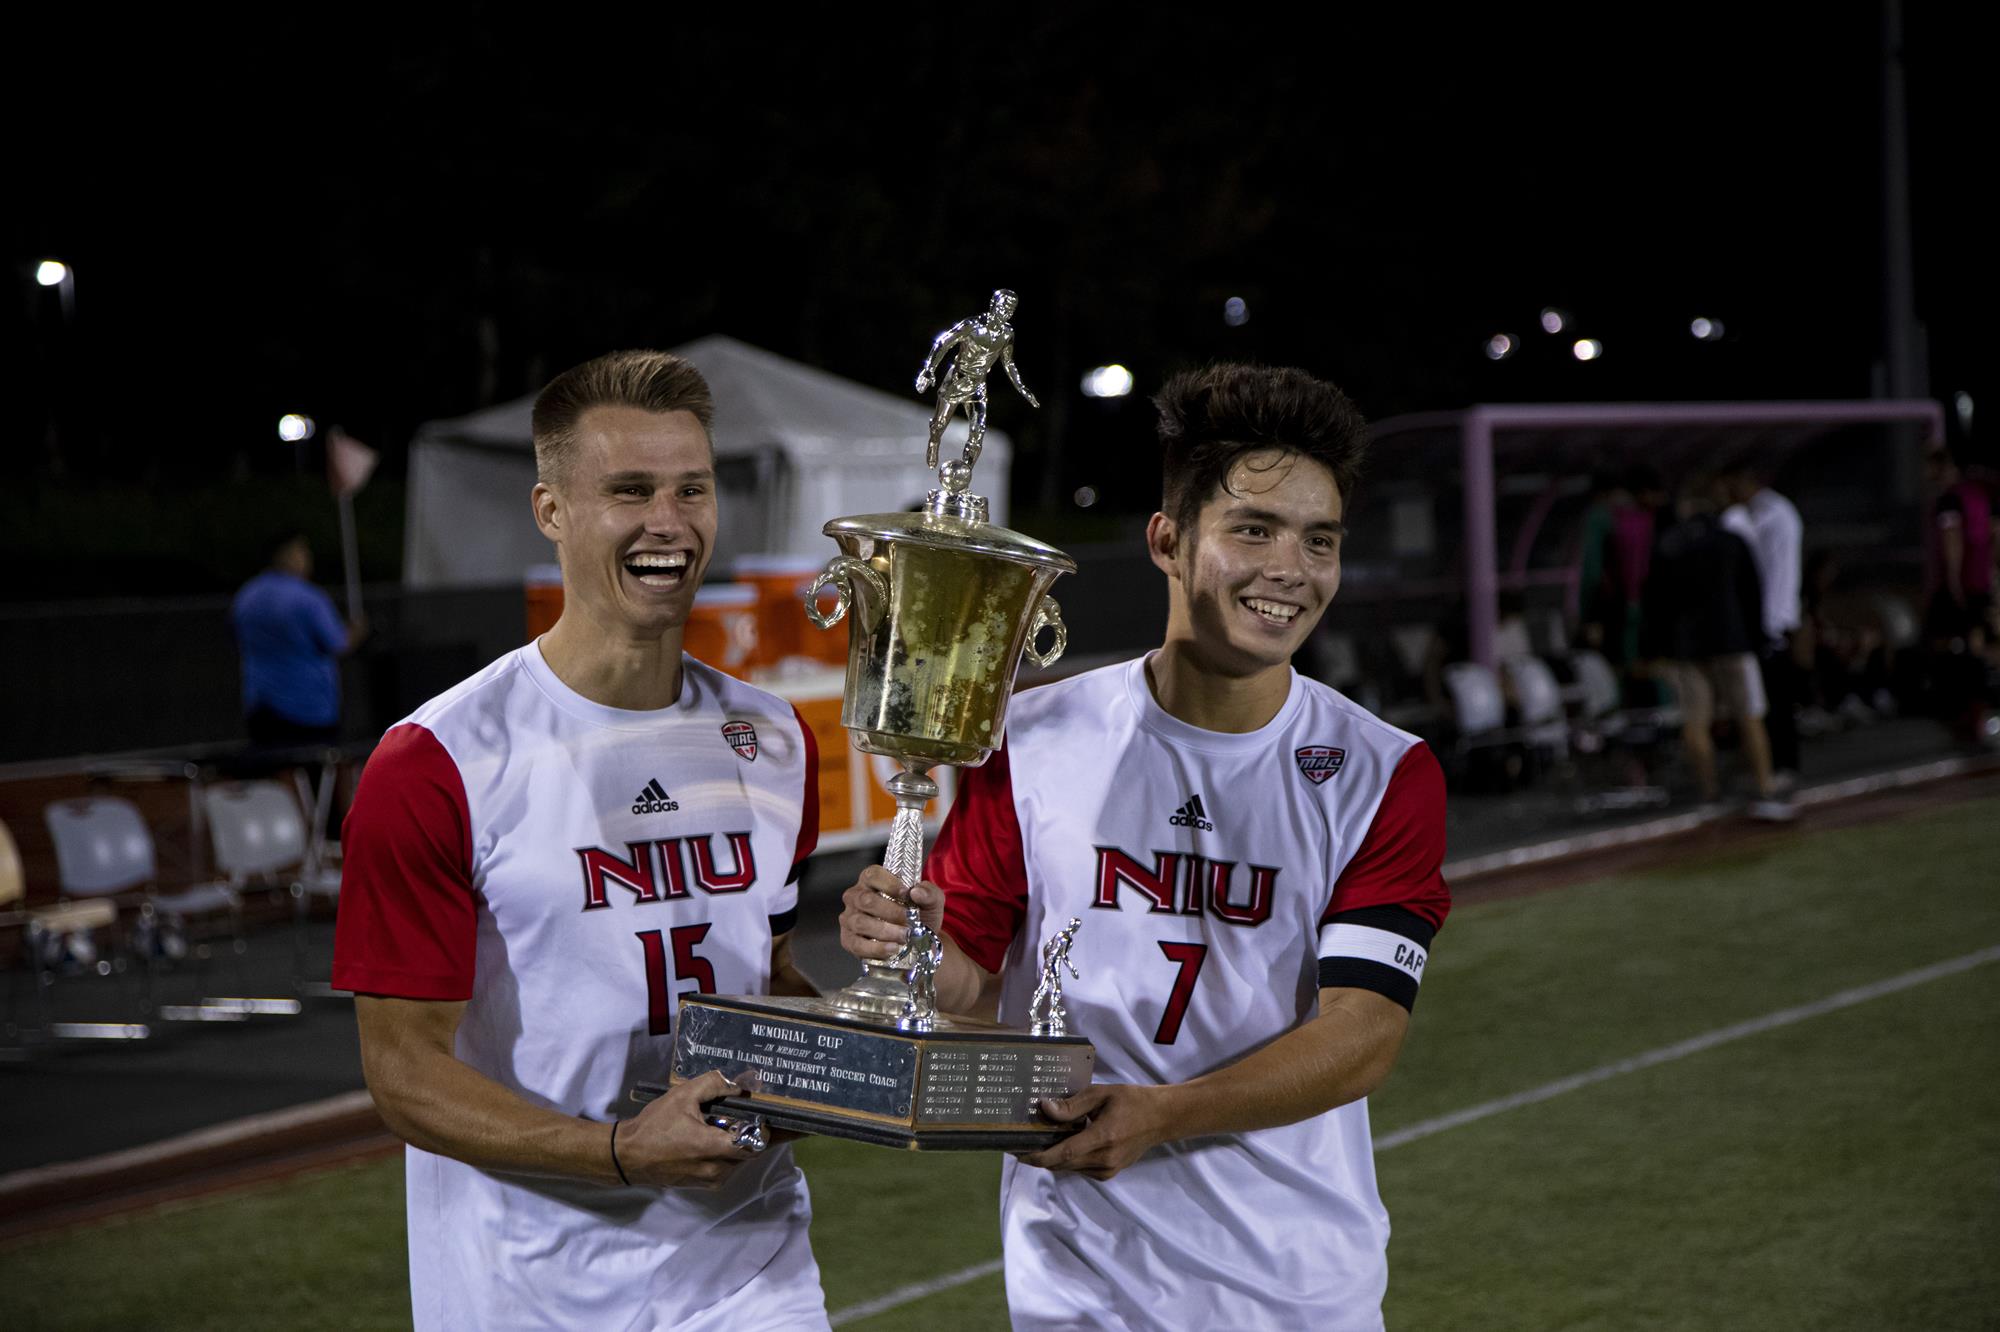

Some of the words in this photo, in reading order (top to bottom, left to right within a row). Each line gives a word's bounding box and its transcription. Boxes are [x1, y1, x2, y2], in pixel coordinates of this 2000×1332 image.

[727, 732, 757, 746] MAC
[1299, 757, 1342, 769] MAC
[631, 799, 679, 815] adidas
[1169, 813, 1213, 832] adidas
[573, 831, 757, 912] NIU
[1089, 844, 1283, 928] NIU
[635, 922, 717, 1036] 15
[1153, 940, 1208, 1045] 7
[751, 1023, 808, 1044] MEMORIAL
[817, 1035, 843, 1049] CUP
[776, 1045, 811, 1058] MEMORY
[813, 1051, 826, 1061] OF
[690, 1042, 734, 1060] NORTHERN
[737, 1050, 774, 1066] ILLINOIS
[776, 1057, 827, 1076] UNIVERSITY
[830, 1066, 866, 1082] SOCCER
[869, 1073, 898, 1088] COACH
[755, 1069, 784, 1085] JOHN
